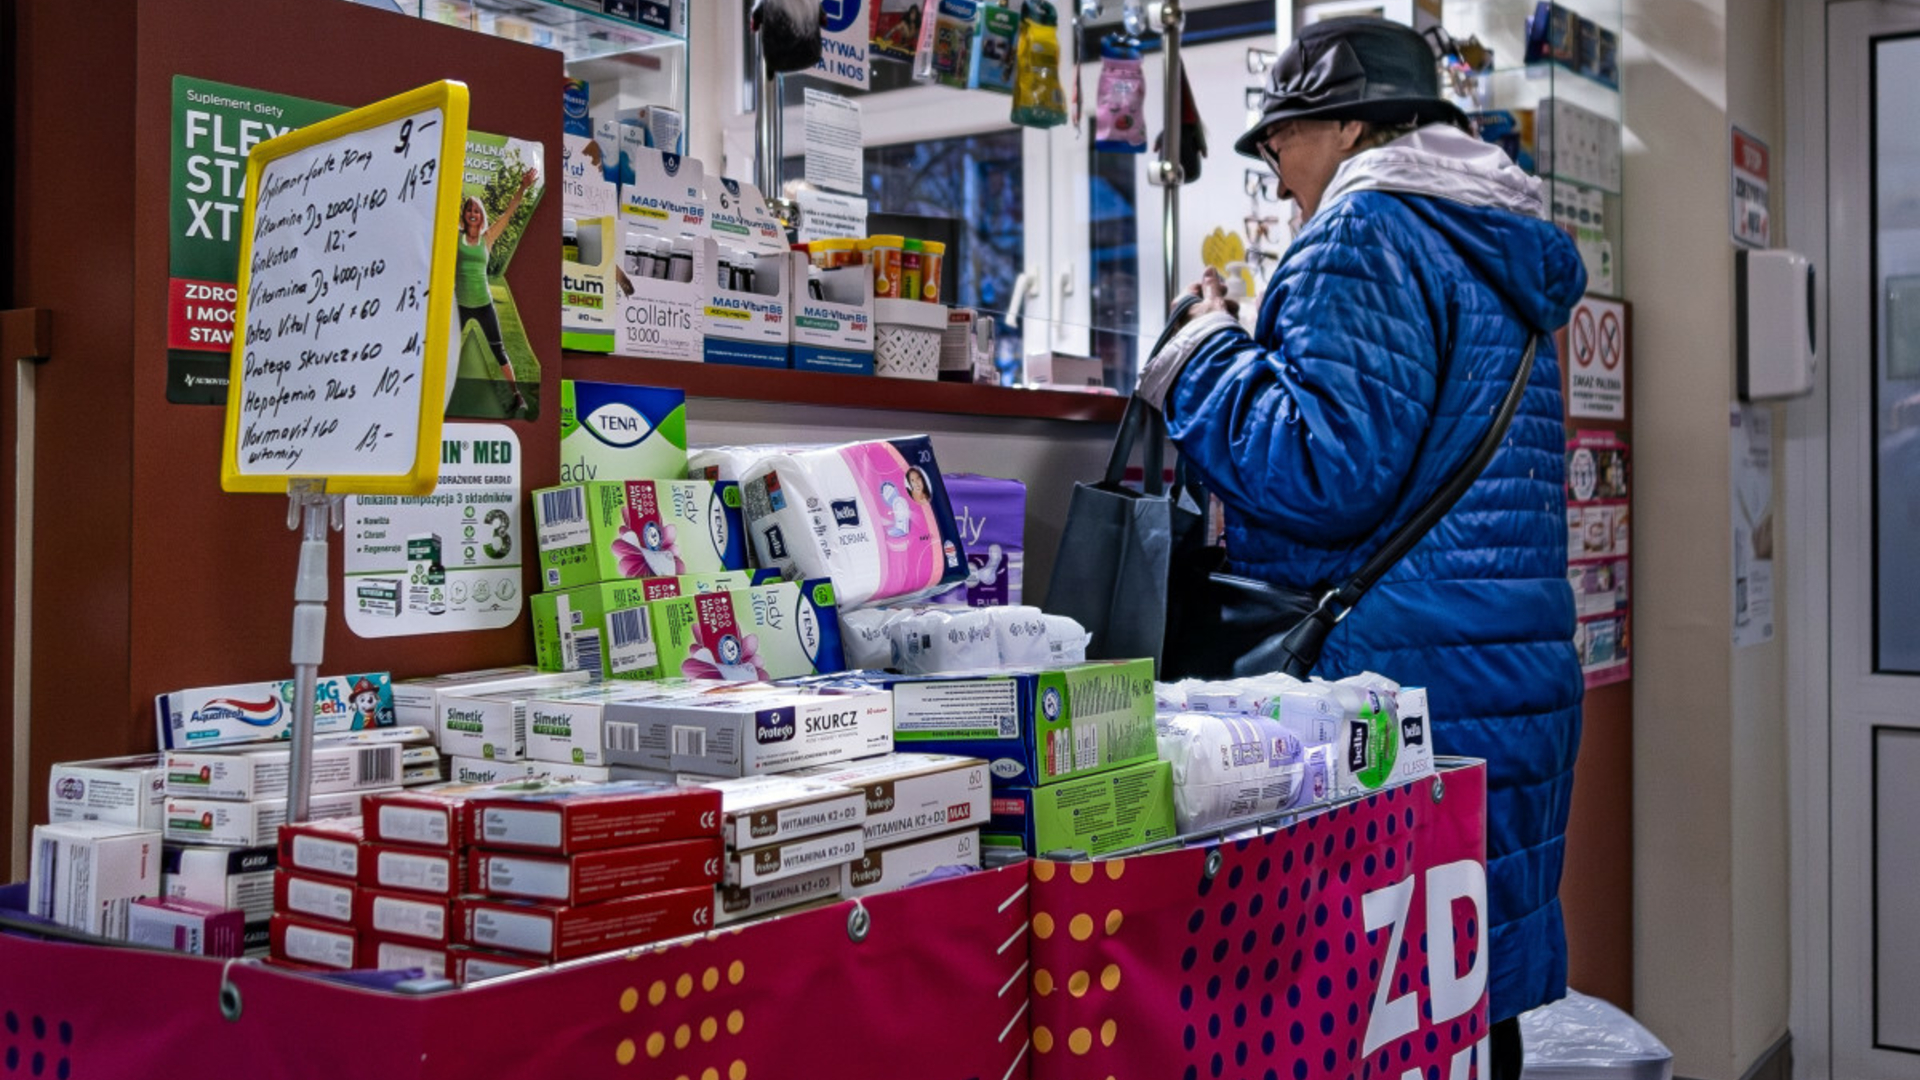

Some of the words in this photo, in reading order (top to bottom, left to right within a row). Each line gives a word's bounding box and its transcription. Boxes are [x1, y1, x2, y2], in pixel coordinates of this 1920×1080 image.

[838, 62, 863, 81] NOS
[187, 90, 251, 111] Suplement
[254, 103, 284, 118] diety
[186, 155, 246, 199] ST
[248, 280, 307, 312] Vitamina
[187, 306, 192, 319] I
[626, 304, 691, 330] collatris
[278, 313, 309, 337] Vital
[245, 352, 291, 386] Protego
[599, 415, 638, 431] TENA
[473, 440, 512, 464] MED
[357, 494, 397, 506] Unikalna
[401, 493, 454, 507] kompozycja
[457, 493, 463, 503] 3
[671, 485, 685, 518] slim
[685, 485, 699, 525] lady
[836, 506, 856, 519] bella
[483, 509, 512, 559] 3
[713, 506, 725, 544] TENA
[839, 534, 870, 545] NORMAL
[700, 599, 710, 625] MINI
[707, 598, 718, 634] ULTRA
[750, 593, 763, 627] slim
[765, 589, 783, 631] lady
[801, 608, 816, 646] TENA
[190, 708, 245, 723] Aquafresh
[447, 708, 484, 722] Simetic
[533, 712, 573, 727] Simetic
[805, 711, 858, 733] SKURCZ
[758, 724, 793, 741] Protego
[1353, 727, 1363, 765] bella
[969, 770, 982, 785] 60
[781, 815, 826, 831] WITAMINA
[864, 818, 913, 838] WITAMINA
[949, 804, 970, 820] MAX
[958, 837, 970, 851] 60
[783, 850, 827, 867] WITAMINA
[754, 887, 799, 903] WITAMINA
